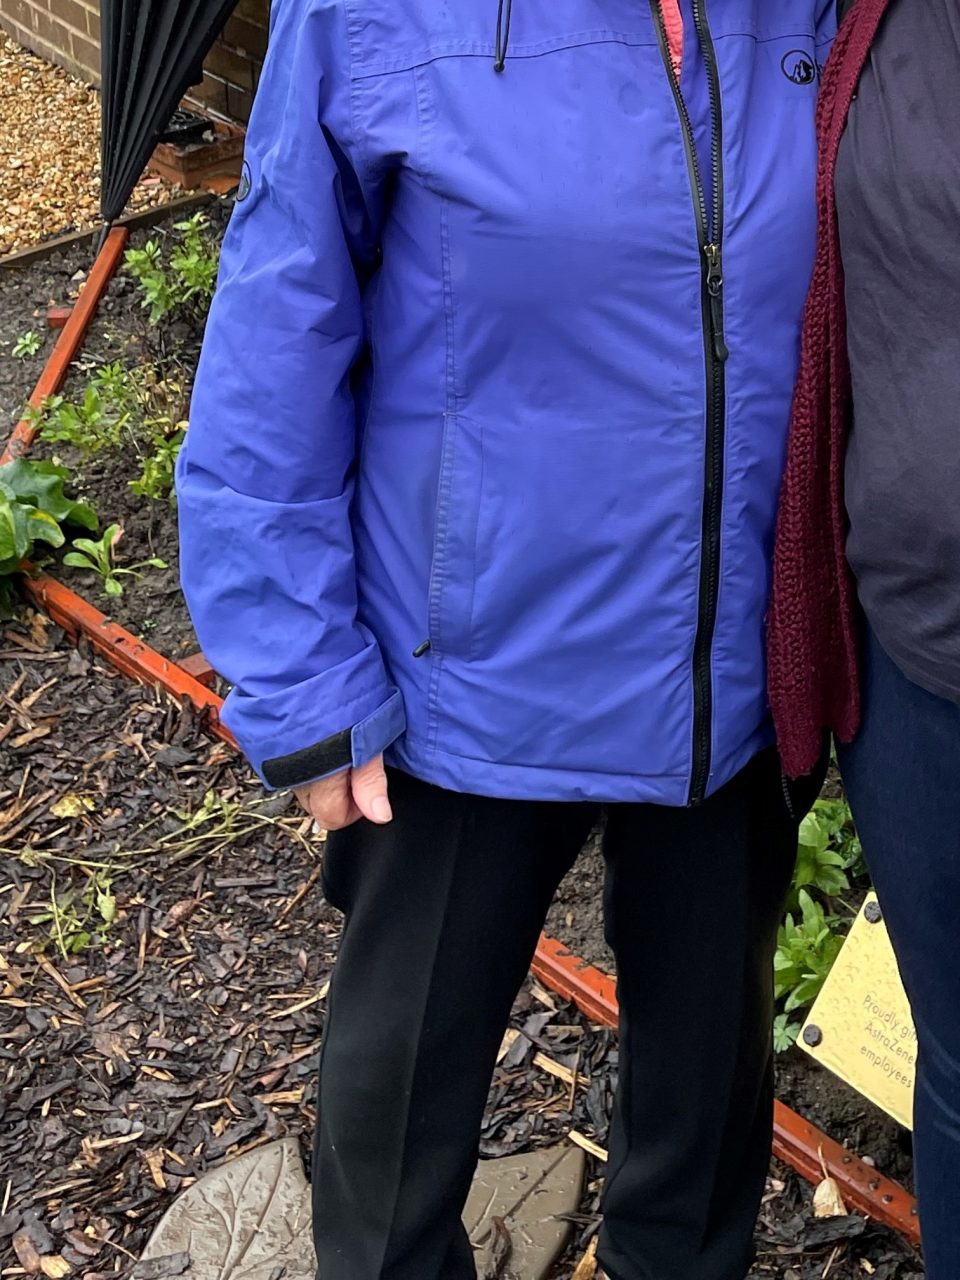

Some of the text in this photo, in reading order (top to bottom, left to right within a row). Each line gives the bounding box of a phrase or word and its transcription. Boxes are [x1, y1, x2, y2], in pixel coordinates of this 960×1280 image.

[863, 994, 917, 1042] Proudly gif
[864, 1022, 914, 1065] AstraZene
[860, 1045, 912, 1088] employees
